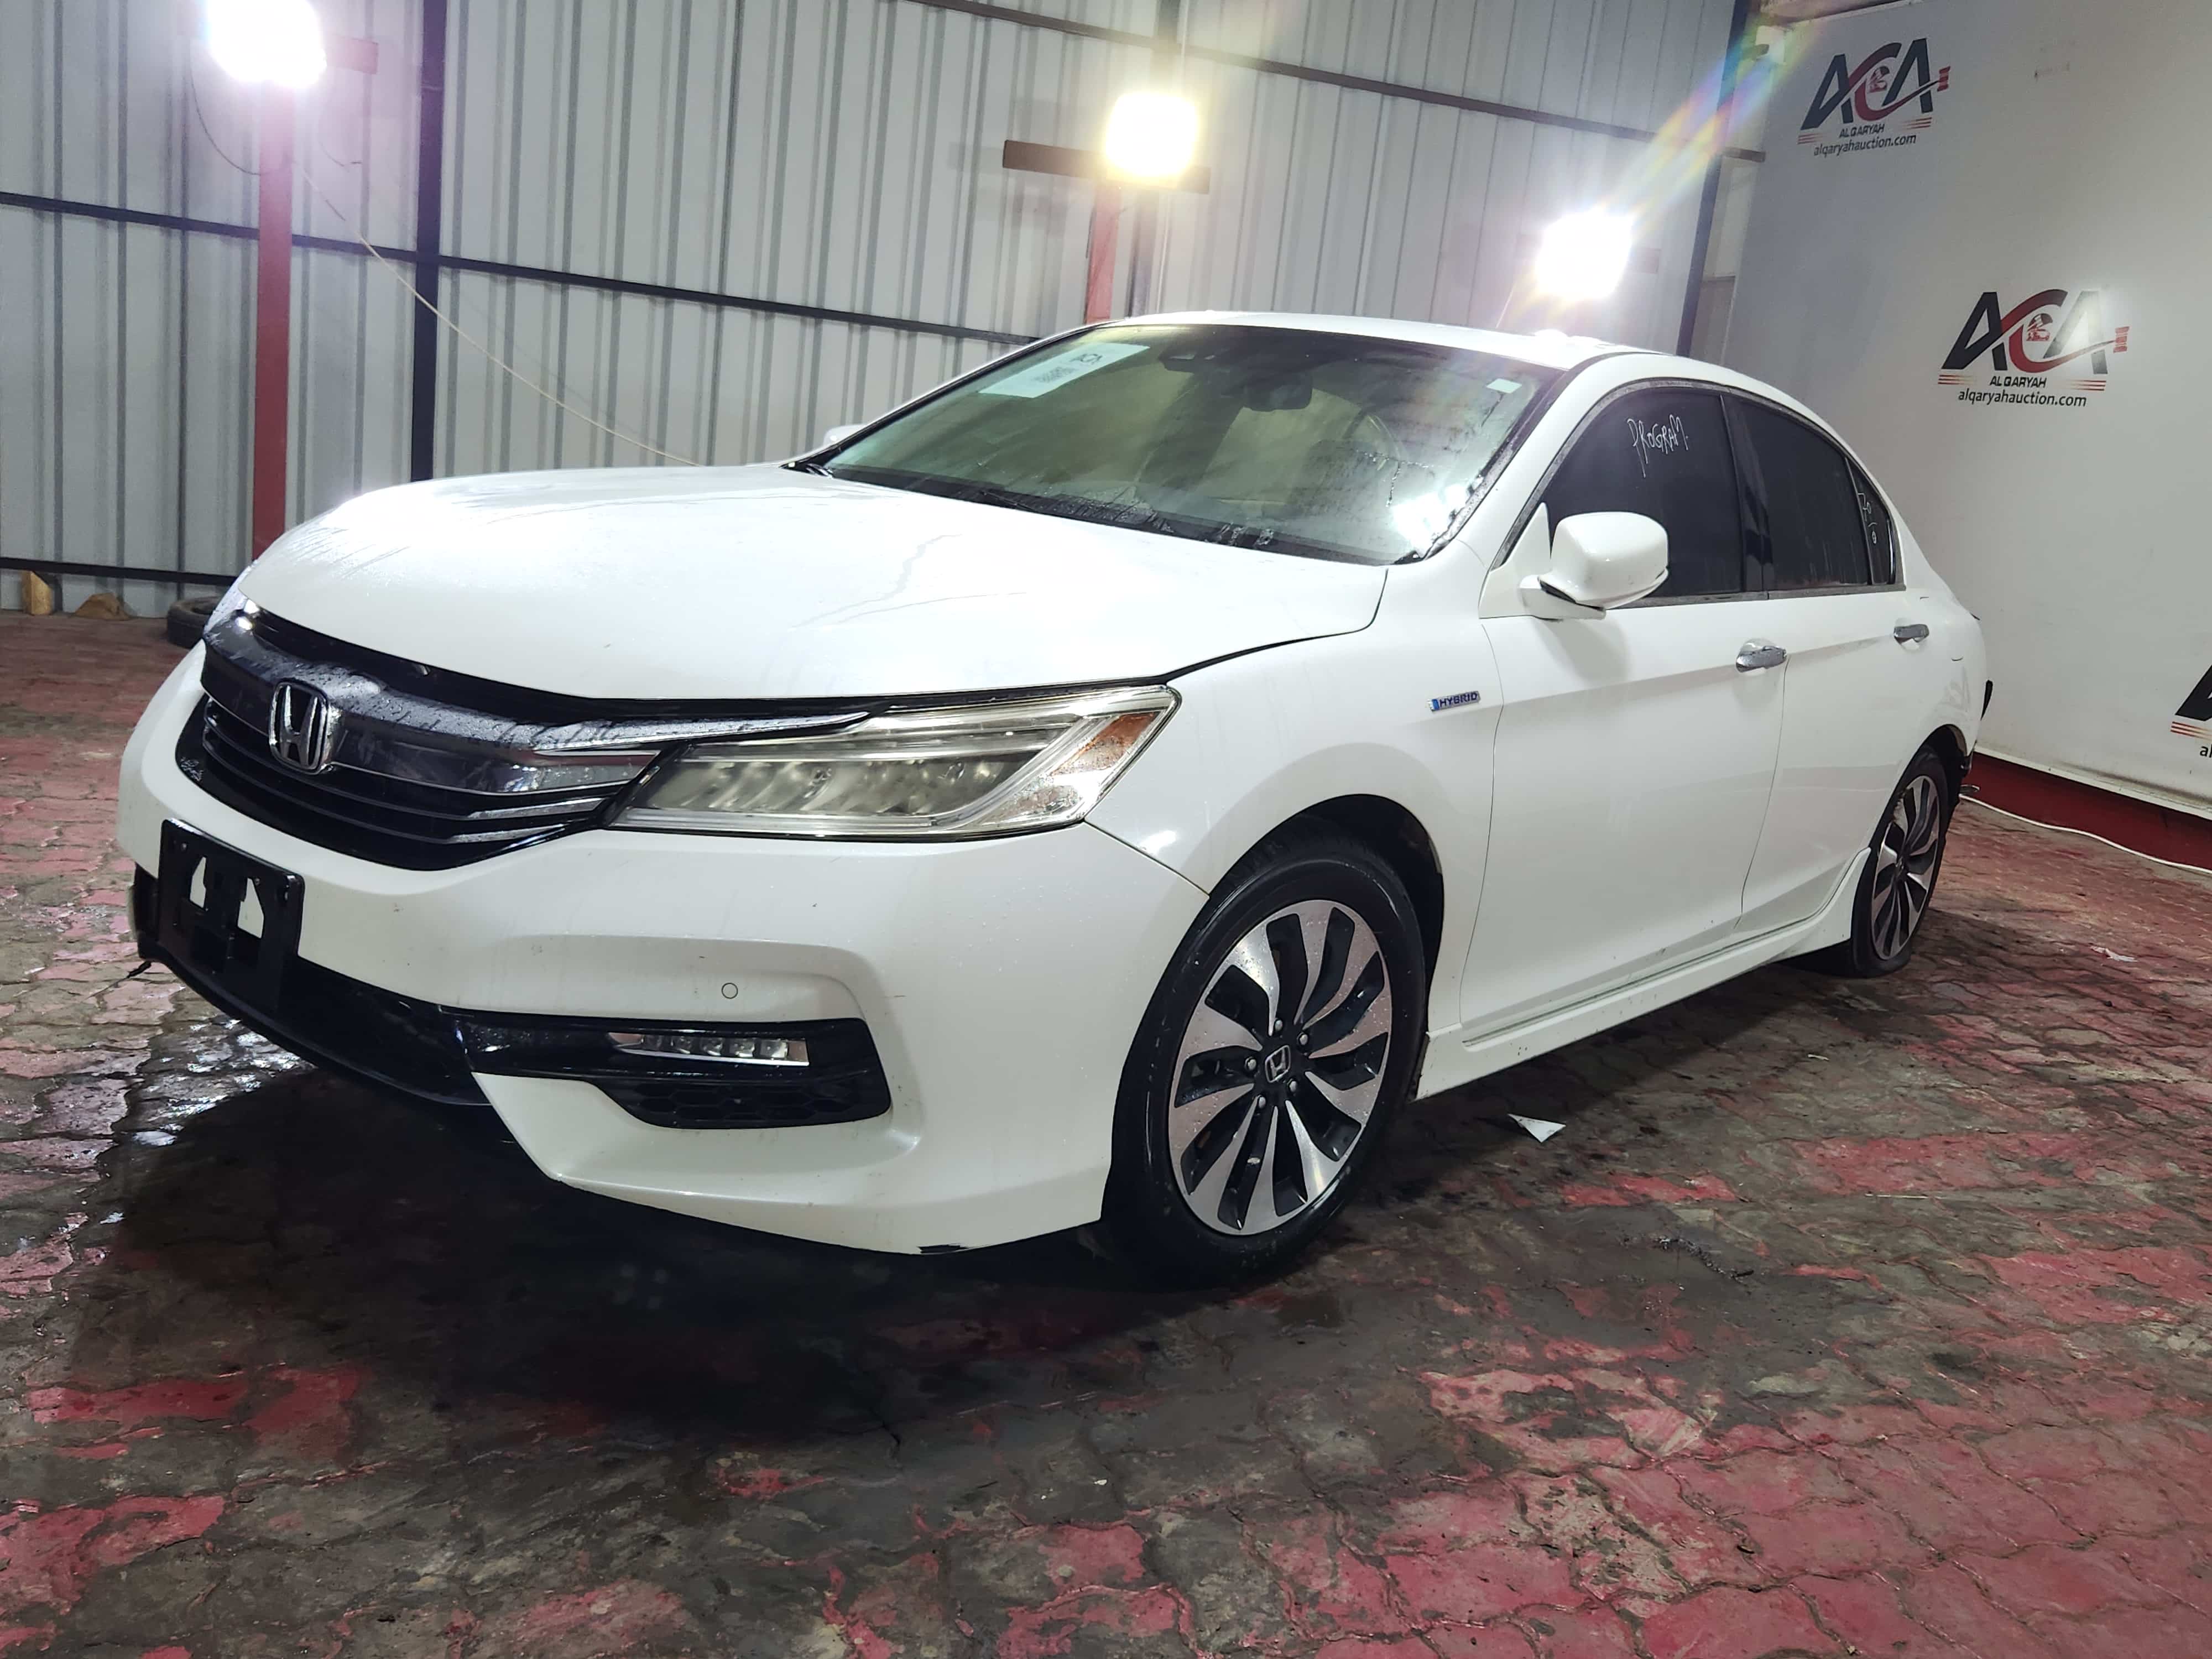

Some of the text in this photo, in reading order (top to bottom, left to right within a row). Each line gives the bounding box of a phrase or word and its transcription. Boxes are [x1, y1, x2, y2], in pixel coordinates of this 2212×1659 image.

[1813, 134, 1917, 157] alqaryahauction.com
[1958, 388, 2087, 406] alqaryahauction.com
[1439, 691, 1478, 708] HYBRID
